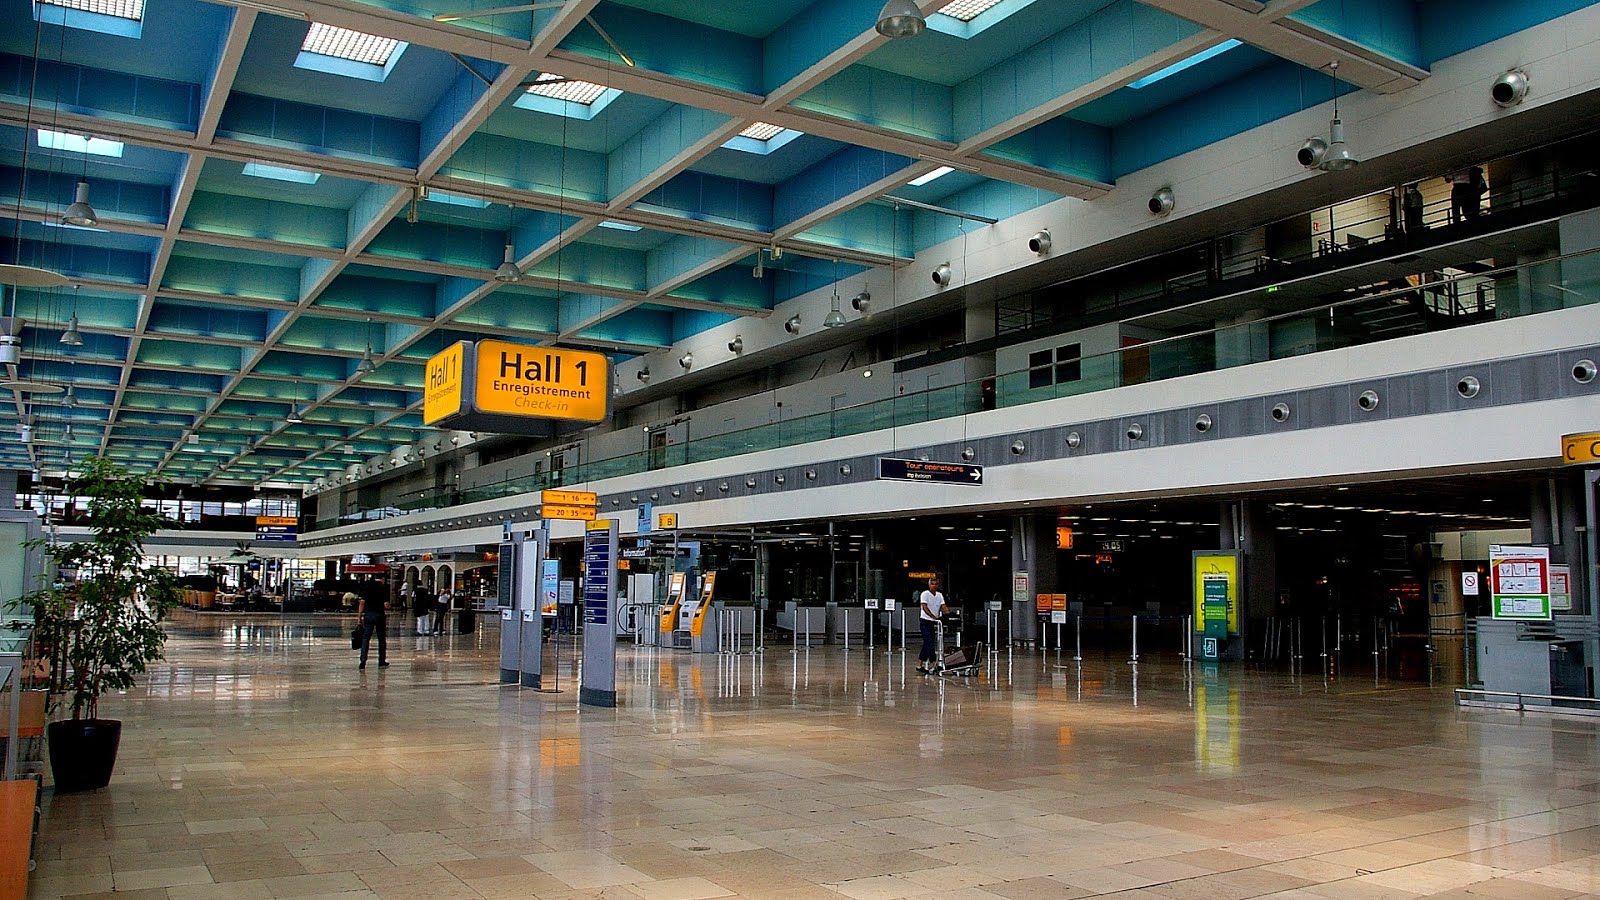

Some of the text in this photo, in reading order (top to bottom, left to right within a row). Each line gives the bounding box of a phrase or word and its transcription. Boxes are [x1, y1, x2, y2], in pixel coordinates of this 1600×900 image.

[431, 354, 456, 390] Hall 1
[500, 351, 588, 386] Hall 1
[493, 380, 591, 399] Enregistrement
[514, 396, 569, 412] Check-in
[1567, 443, 1576, 461] C
